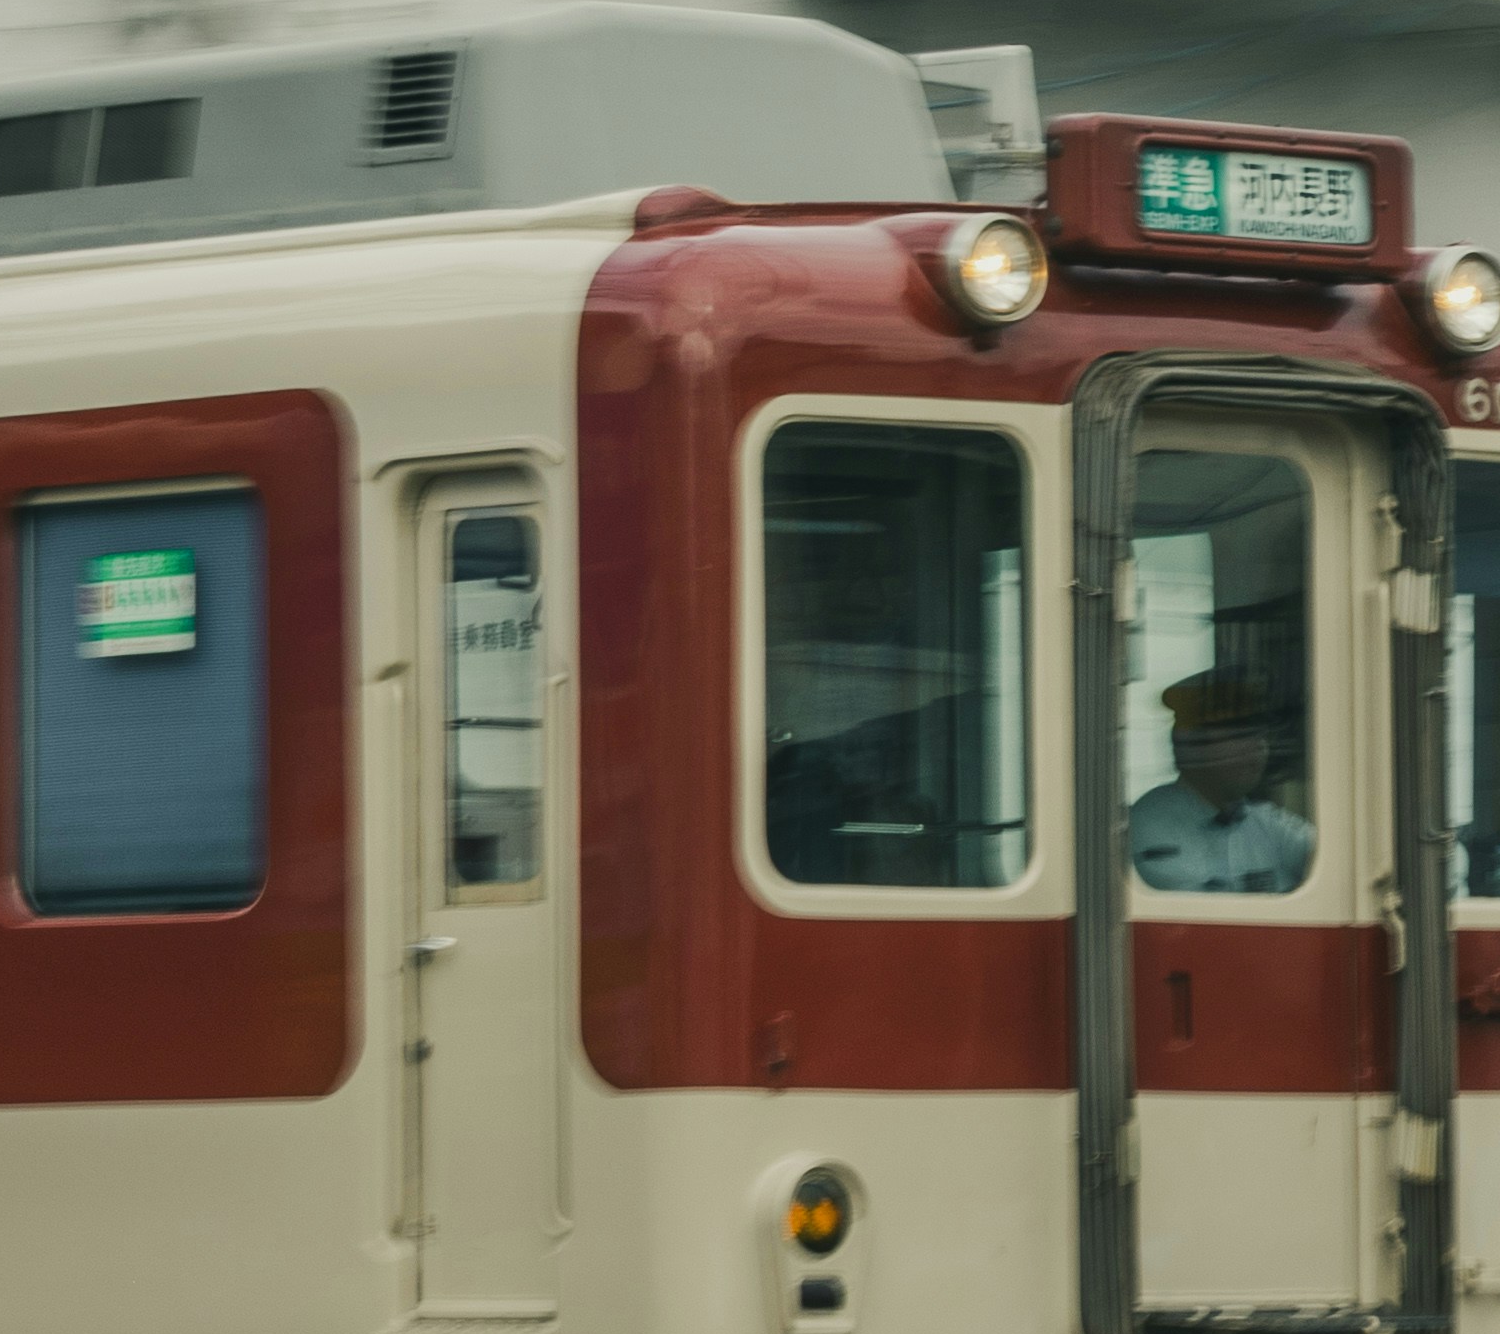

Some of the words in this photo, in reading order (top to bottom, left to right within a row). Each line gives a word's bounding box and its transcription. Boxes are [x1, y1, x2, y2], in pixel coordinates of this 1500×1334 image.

[1139, 153, 1218, 210] 準急
[1240, 162, 1353, 218] 河内長野
